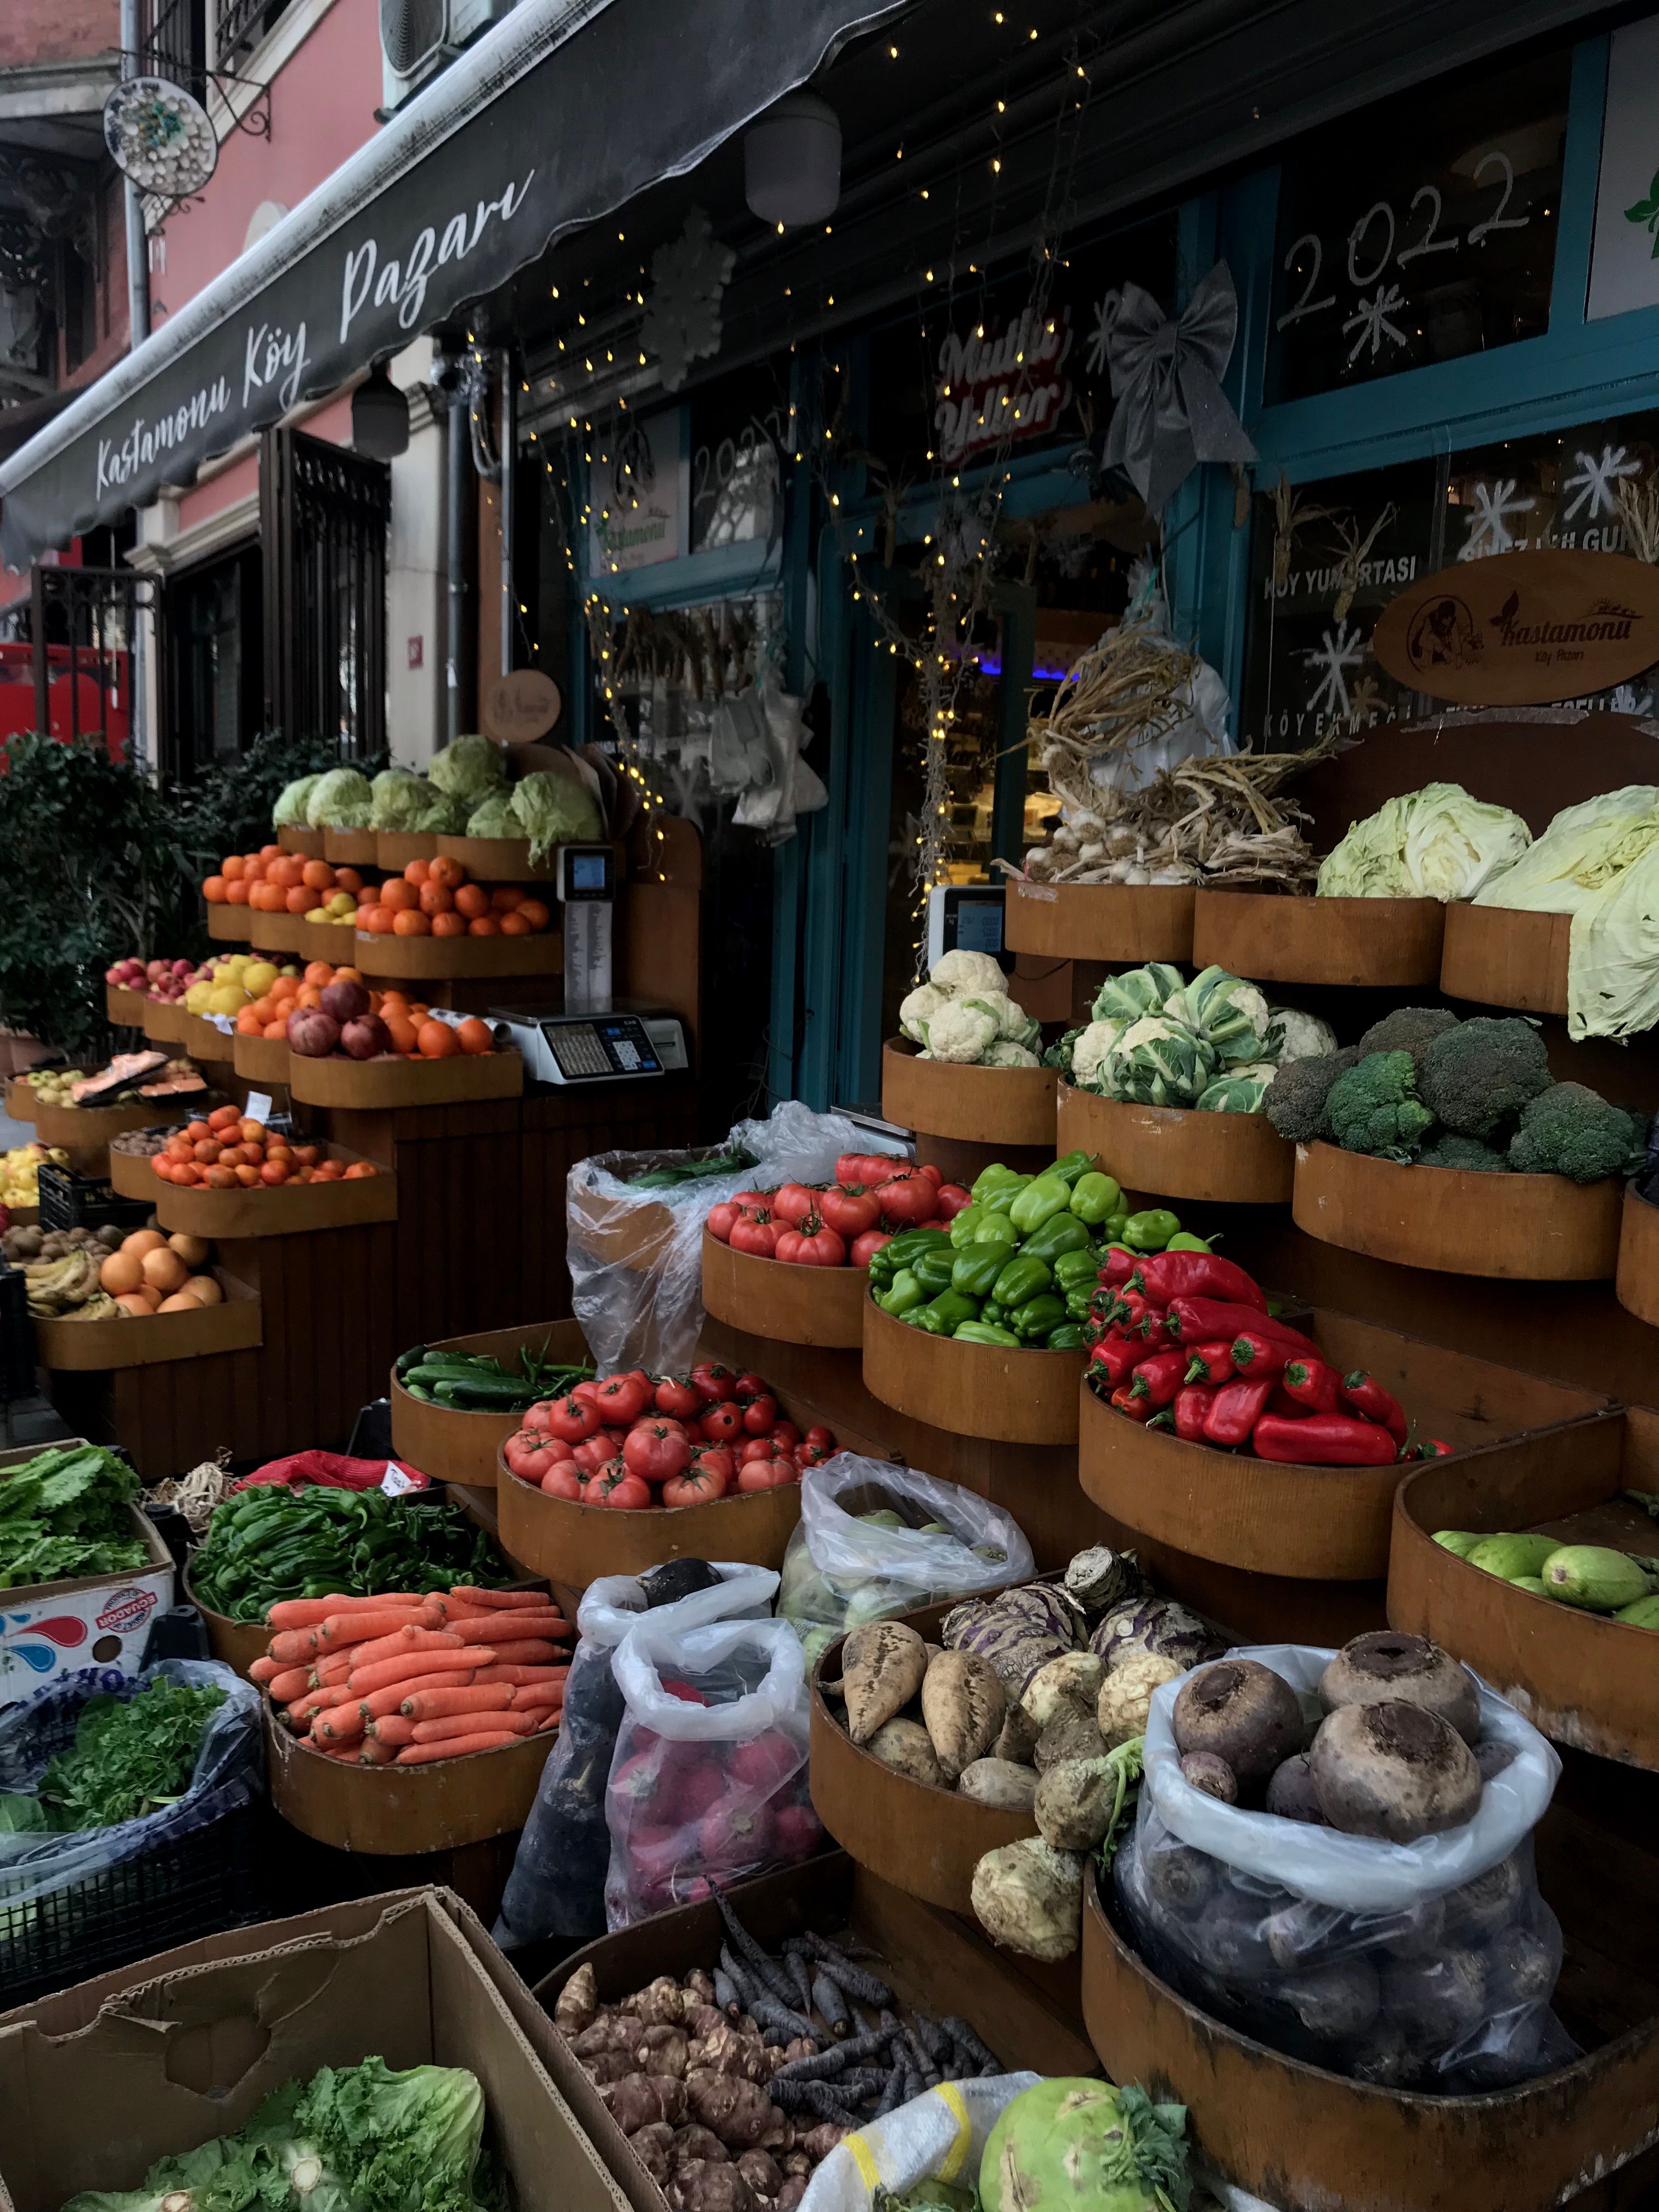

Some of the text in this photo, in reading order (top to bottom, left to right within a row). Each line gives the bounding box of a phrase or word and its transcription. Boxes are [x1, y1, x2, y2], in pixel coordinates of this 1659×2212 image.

[1277, 151, 1530, 332] 2022
[95, 168, 535, 500] Kastamonu Köy Pazarı
[1305, 554, 1417, 594] YUMRTASI
[1500, 619, 1633, 647] Kastamonu
